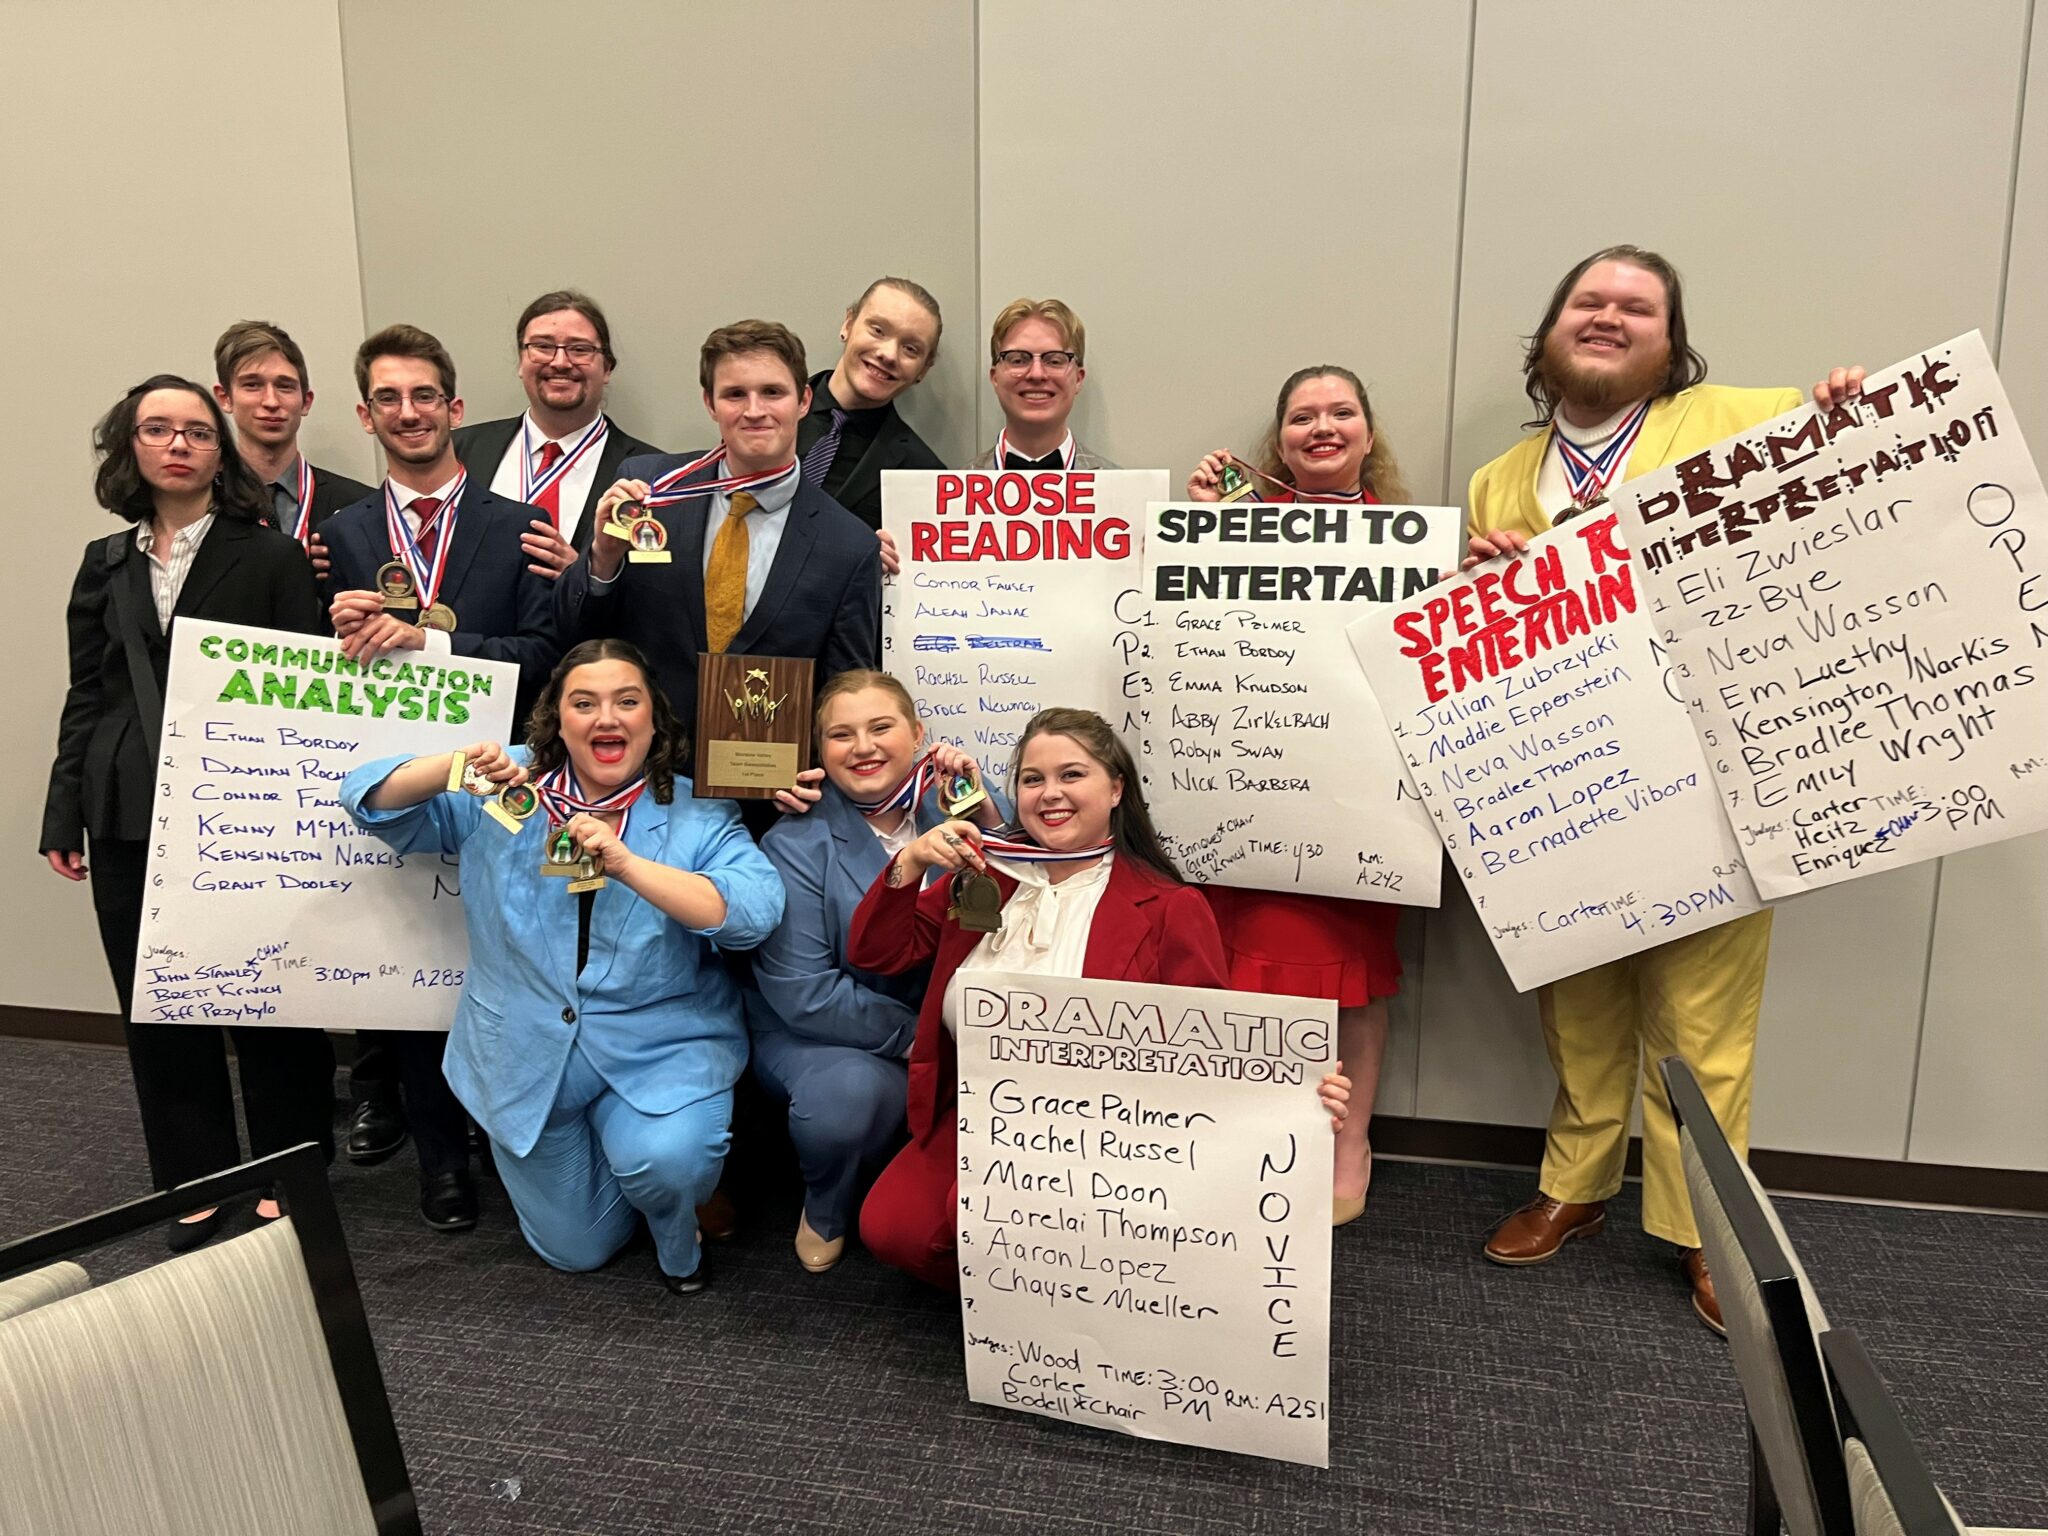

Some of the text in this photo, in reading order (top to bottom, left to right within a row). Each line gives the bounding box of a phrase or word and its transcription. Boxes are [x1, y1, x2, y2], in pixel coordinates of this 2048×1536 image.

[1636, 350, 1960, 525] DRAMATIC
[936, 472, 1096, 516] PROSE
[1640, 405, 1999, 575] INTERPRETATION
[911, 517, 1131, 563] READING
[1156, 508, 1428, 544] SPEECH TO
[1677, 499, 1912, 604] Eli Zwieslar
[1155, 566, 1438, 603] ENTERTAIN
[1393, 545, 1566, 658] SPEECH
[1176, 611, 1222, 631] GRACE
[1419, 563, 1637, 704] ENTERTAIN
[1707, 635, 1794, 675] Neva
[1797, 582, 1948, 643] Wasson
[1174, 641, 1226, 658] ETHAN
[1234, 640, 1296, 666] BORDOY
[1719, 682, 1786, 709] Em
[1795, 633, 1913, 689] Luethy
[216, 668, 471, 725] ANALYSIS
[1169, 671, 1223, 692] EMMA
[1416, 694, 1495, 737] Julian
[1495, 633, 1619, 700] Zubrzycki
[1732, 682, 1894, 743] Kensington
[1914, 637, 2010, 684] Narkis
[1172, 704, 1219, 736] ABBY
[1429, 720, 1506, 764] Maddie
[1508, 666, 1632, 727] Eppenstein
[1741, 721, 1873, 775] Bradlee
[1874, 664, 2035, 730] Thomas
[277, 728, 359, 752] BORDOY
[1231, 740, 1284, 760] SWAN
[1442, 756, 1509, 793] Neva
[1508, 713, 1615, 762] Wasson
[201, 757, 290, 777] DAMIAN
[1171, 768, 1311, 792] NICK BARBERA
[1453, 778, 1537, 820] Bradlee
[1534, 739, 1621, 781] Thomas
[192, 784, 283, 801] CONNOR
[296, 788, 342, 809] FAUS
[1469, 805, 1544, 847] Aaron
[1548, 768, 1640, 815] Lopez
[1793, 797, 1868, 827] Carter
[1947, 799, 2005, 831] PM
[198, 812, 275, 838] KENNY
[1480, 806, 1628, 875] Bernadette
[1624, 772, 1698, 812] Vibora
[198, 841, 322, 862] KENSINGTON
[335, 843, 405, 868] NARKIS
[1248, 840, 1288, 854] TIME:
[1792, 836, 1896, 876] Enriquez
[192, 871, 267, 892] GRANT
[276, 874, 353, 893] DOOLEY
[1356, 867, 1404, 892] A242
[1538, 900, 1606, 933] Carter
[412, 969, 465, 988] A283
[964, 987, 1331, 1063] DRAMATIC
[990, 1035, 1304, 1086] INTERPRETATION
[990, 1079, 1096, 1119] Grace
[1101, 1093, 1216, 1129] Palmer
[990, 1116, 1087, 1160] Rachel
[1099, 1130, 1196, 1171] Russel
[983, 1159, 1074, 1197] Marel
[1092, 1172, 1168, 1210] Doon
[983, 1195, 1087, 1233] Lorelai
[1096, 1207, 1238, 1252] Thompson
[986, 1227, 1073, 1268] Aaron
[1080, 1245, 1177, 1285] Lopez
[988, 1267, 1095, 1307] Chayse
[1103, 1288, 1219, 1320] Mueller
[1017, 1339, 1081, 1373] Wood
[1097, 1363, 1220, 1396] TIME: 3:00
[1090, 1399, 1147, 1421] Chair
[1164, 1393, 1212, 1421] PM
[1265, 1393, 1326, 1421] A251
